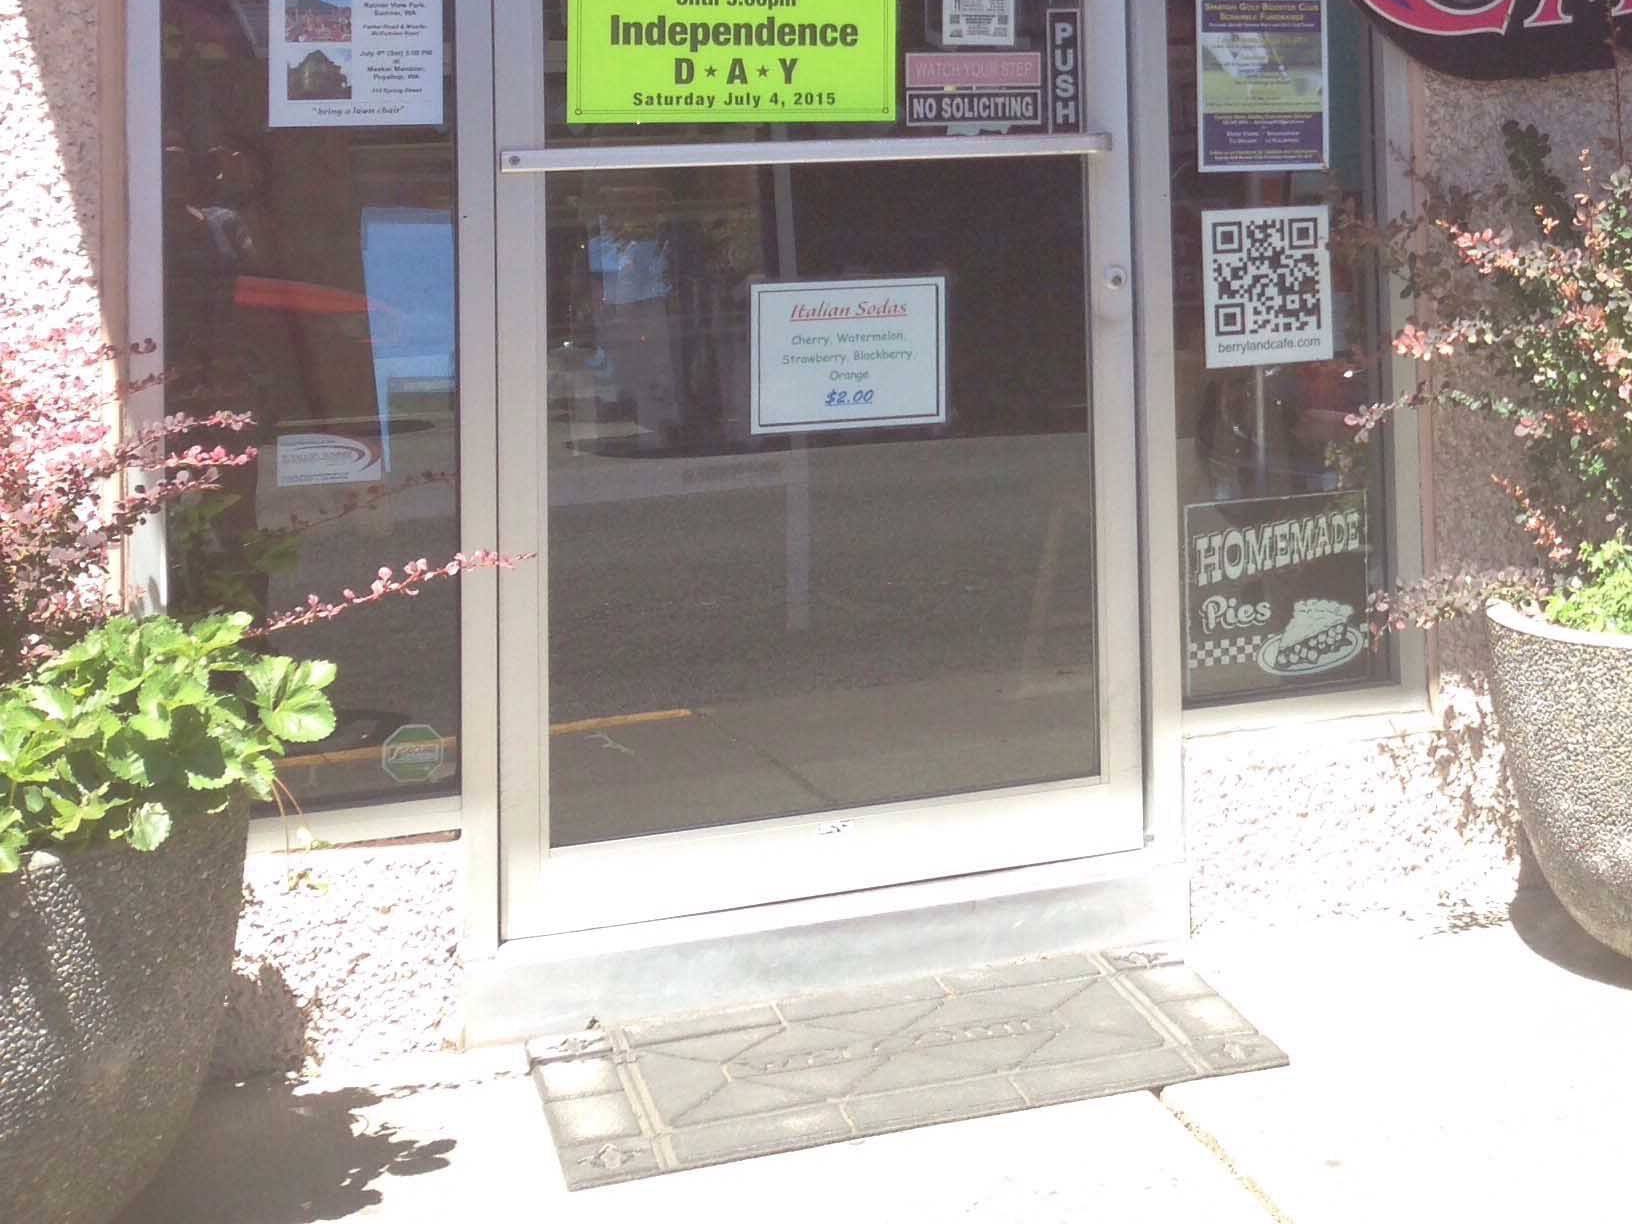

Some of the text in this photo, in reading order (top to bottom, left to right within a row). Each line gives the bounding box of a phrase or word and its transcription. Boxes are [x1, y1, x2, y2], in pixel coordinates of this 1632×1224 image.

[610, 15, 858, 52] Independence
[1054, 22, 1075, 124] PUSH
[633, 92, 836, 109] Saturday July 4, 2015
[912, 96, 1034, 119] NO SOLICITING
[790, 298, 907, 320] Italian Sodas
[1218, 337, 1321, 355] berrylandcafe.com
[829, 369, 869, 382] Orange
[825, 389, 874, 407] $2.00
[1194, 509, 1360, 587] HOMEMADE
[1200, 595, 1272, 634] Pies
